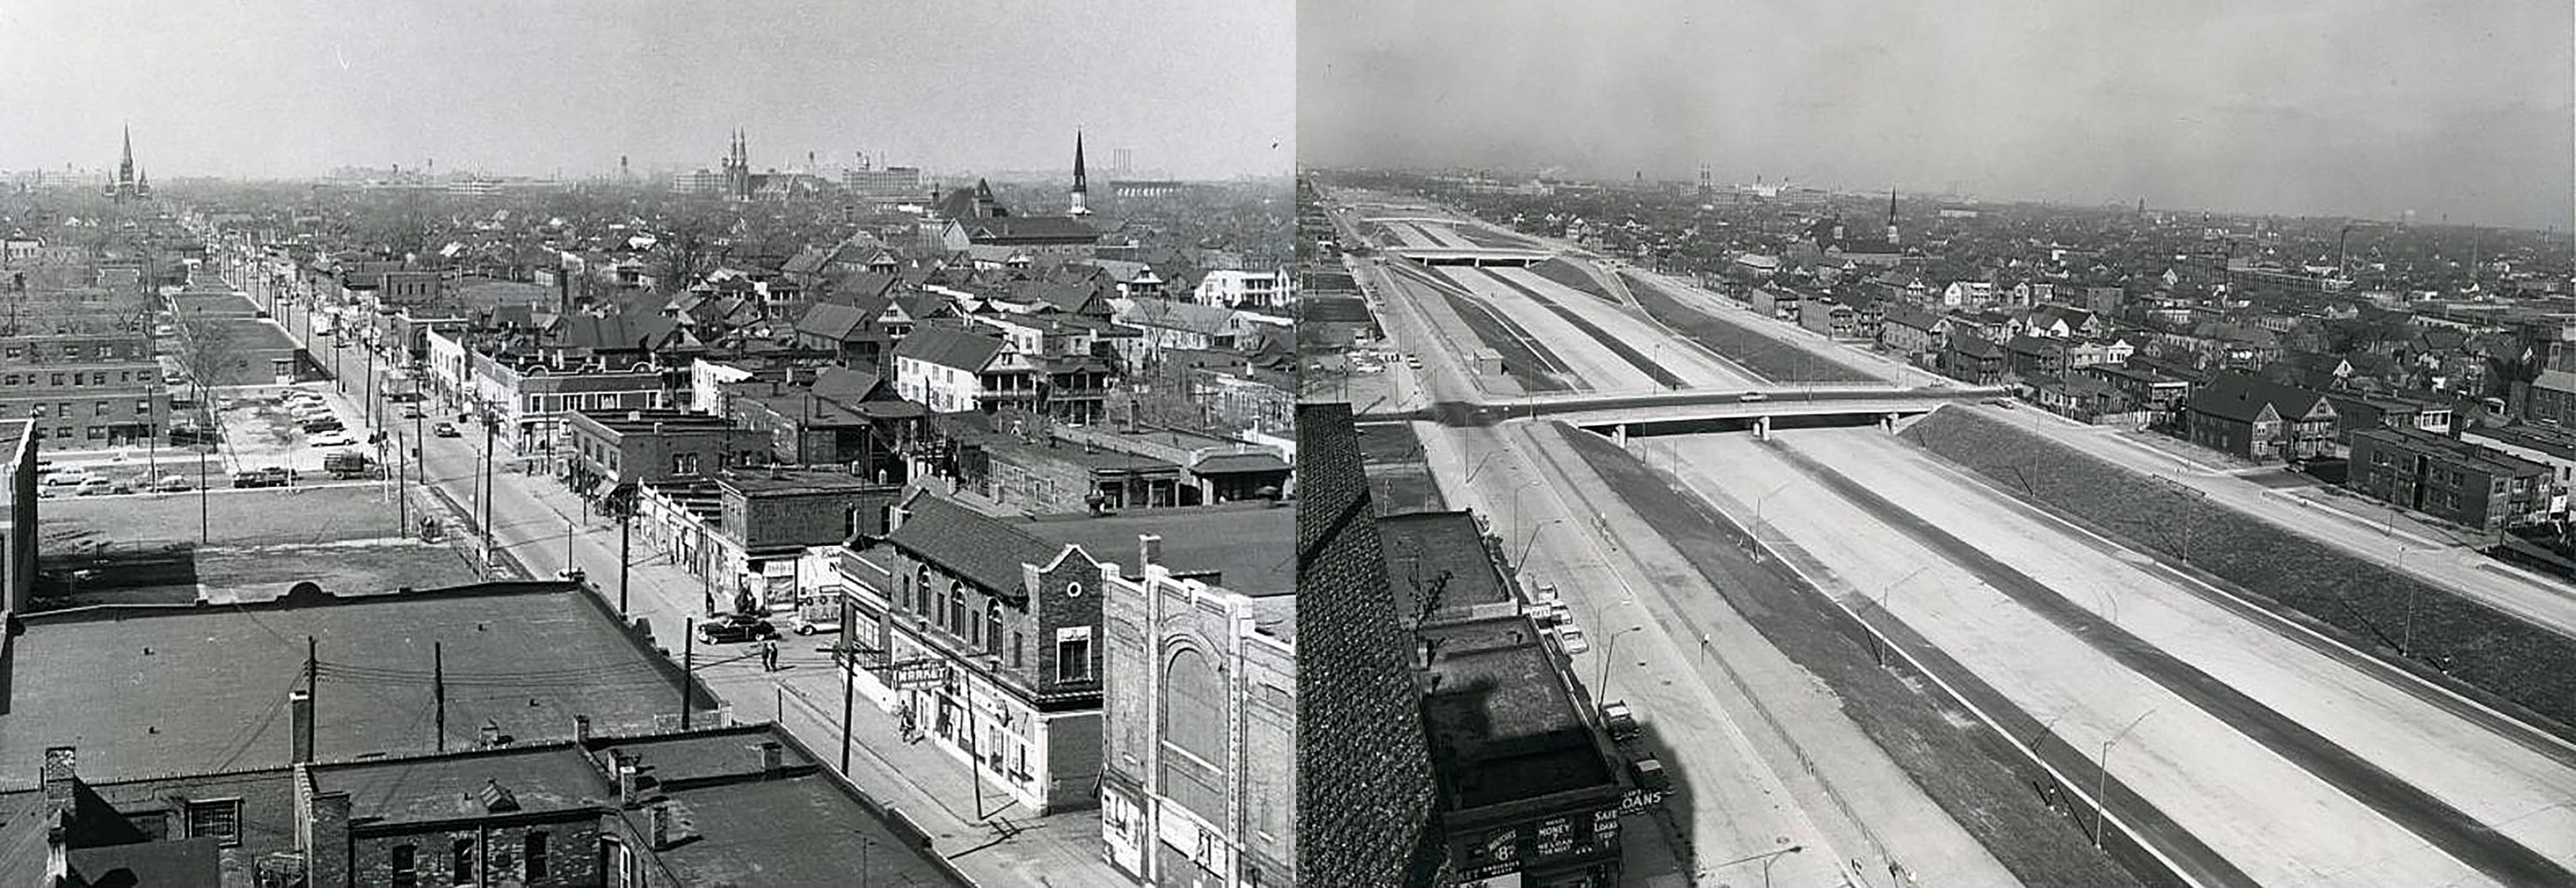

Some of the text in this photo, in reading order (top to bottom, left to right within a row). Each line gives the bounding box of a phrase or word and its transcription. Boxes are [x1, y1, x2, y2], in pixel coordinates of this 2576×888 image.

[898, 667, 946, 683] MARKET
[1619, 791, 1662, 811] OANS
[1538, 824, 1571, 836] MONEY
